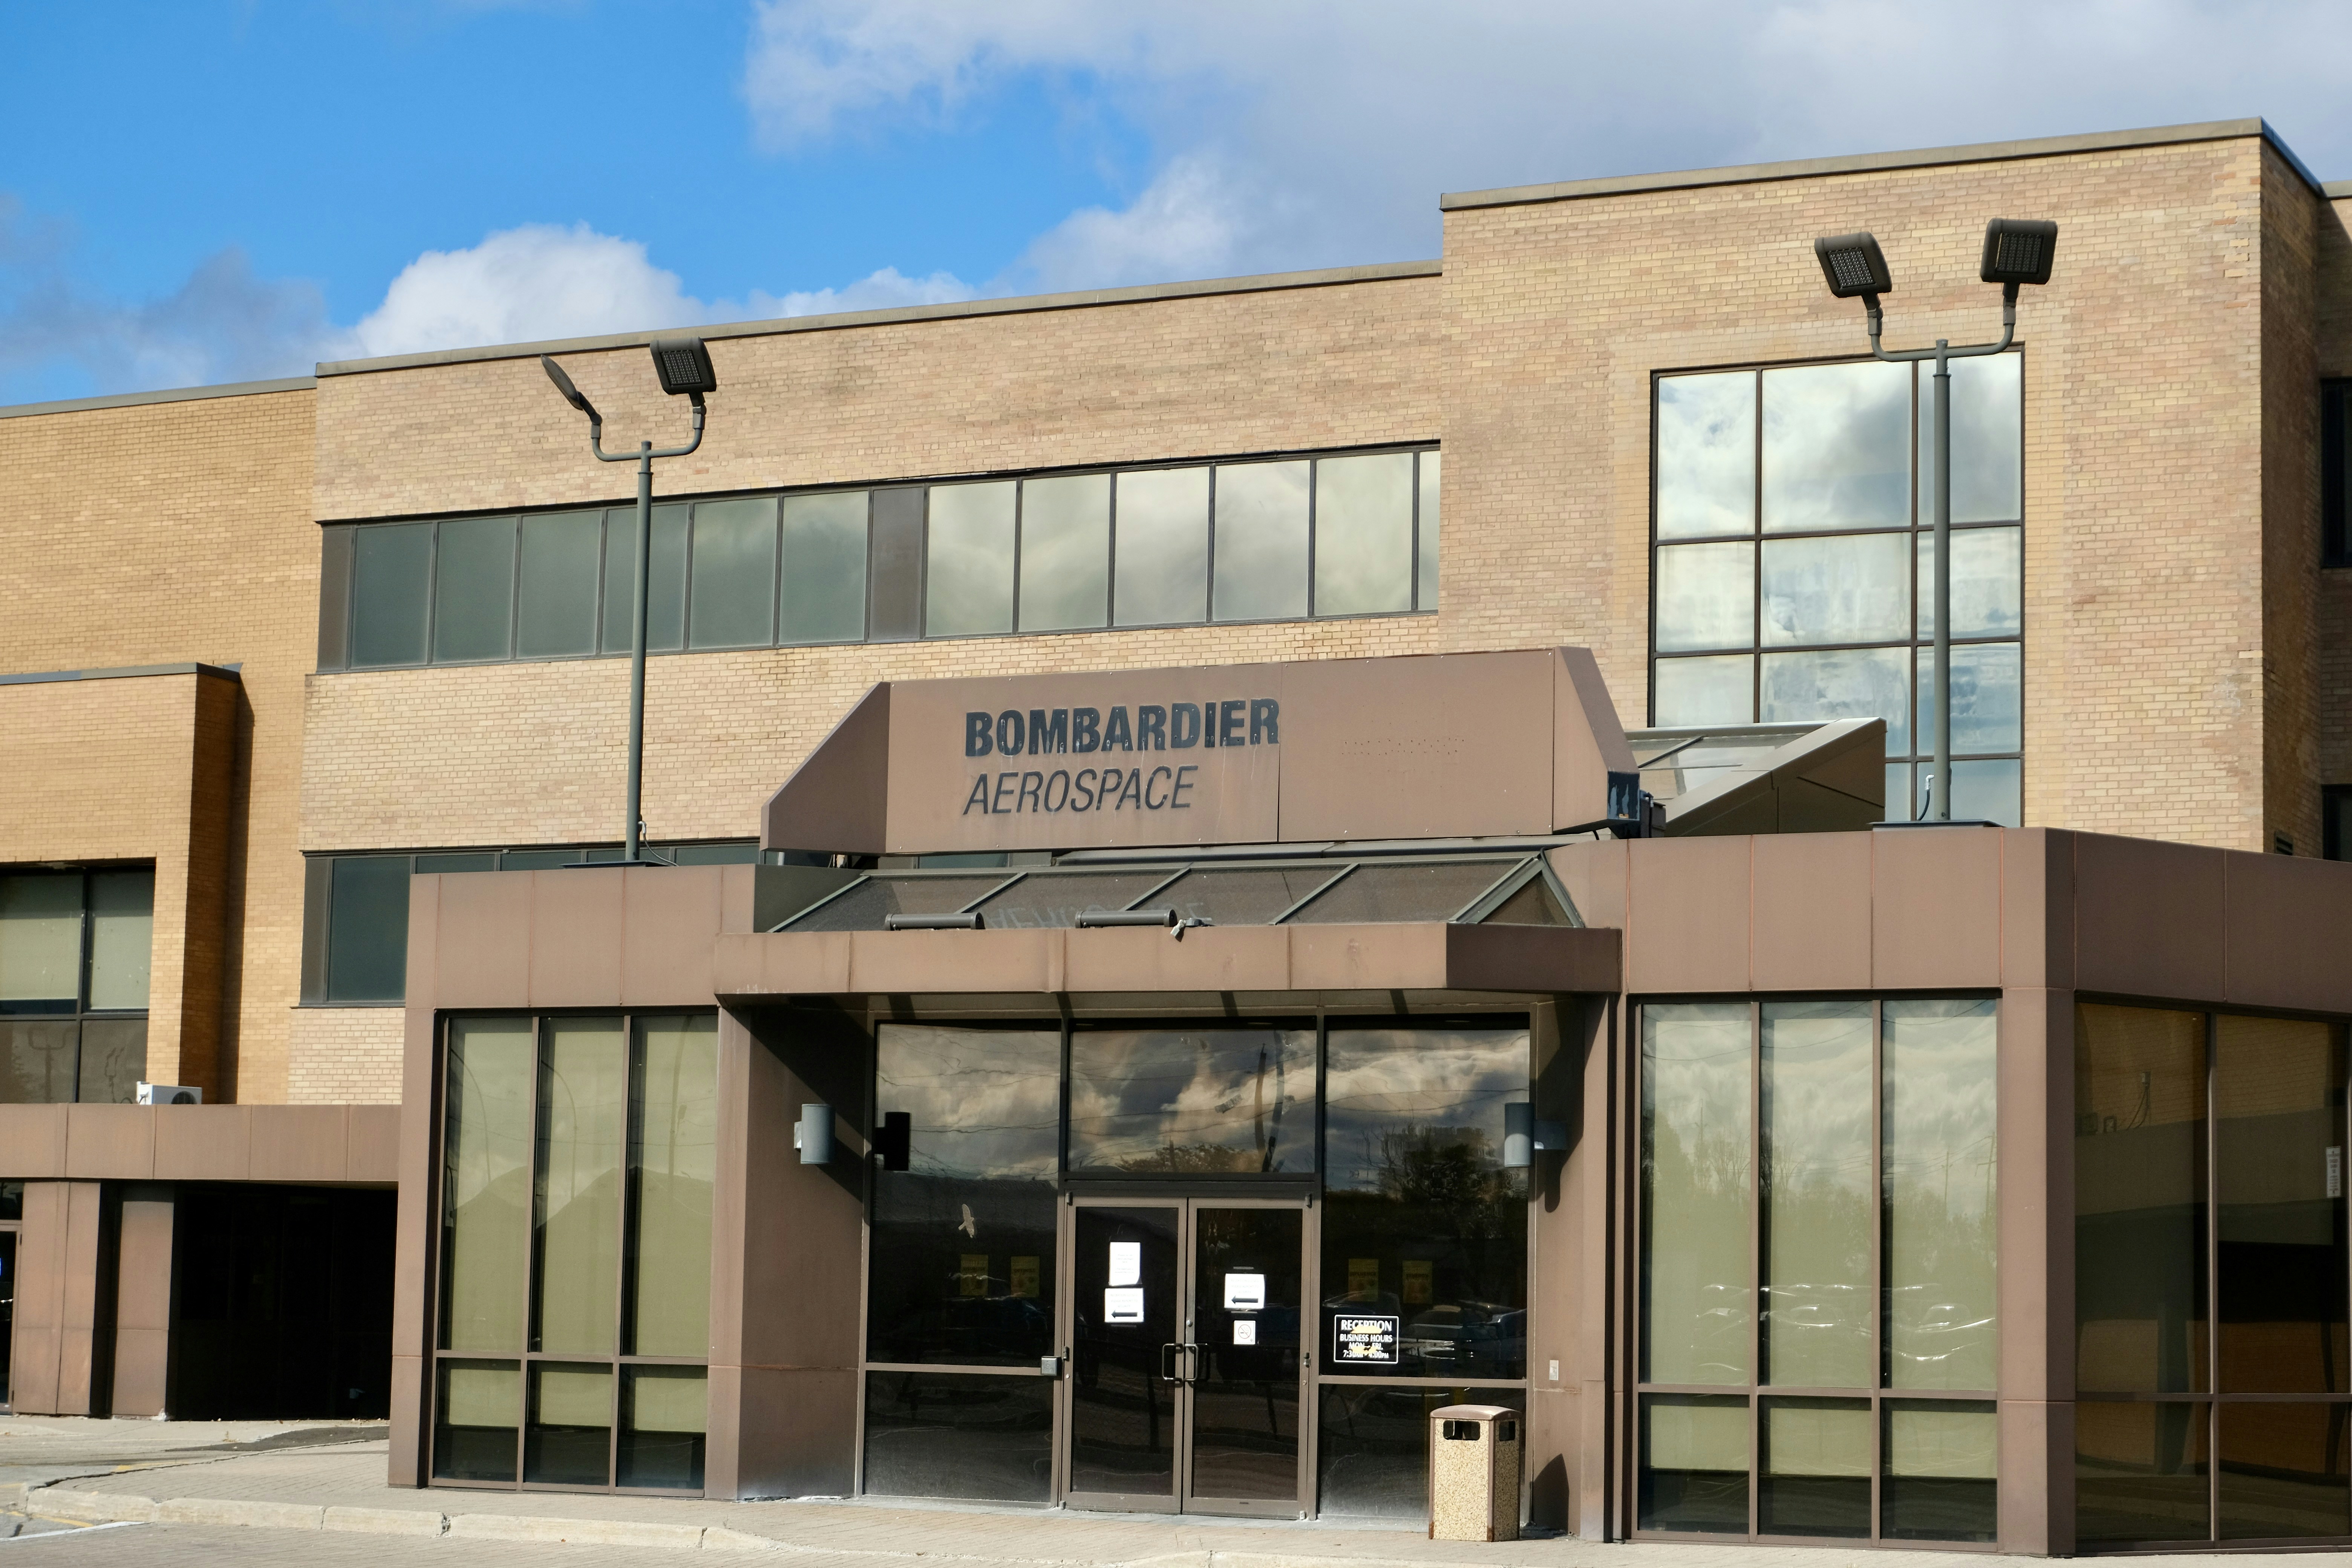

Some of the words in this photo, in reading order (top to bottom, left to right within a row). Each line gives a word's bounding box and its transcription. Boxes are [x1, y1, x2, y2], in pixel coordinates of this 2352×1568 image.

[965, 698, 1280, 757] BOMBARDIER
[963, 765, 1198, 815] AEROSPACE
[1340, 1333, 1369, 1342] BUSINESS
[1370, 1334, 1393, 1343] HOURS
[1341, 1320, 1392, 1331] RECEPTION
